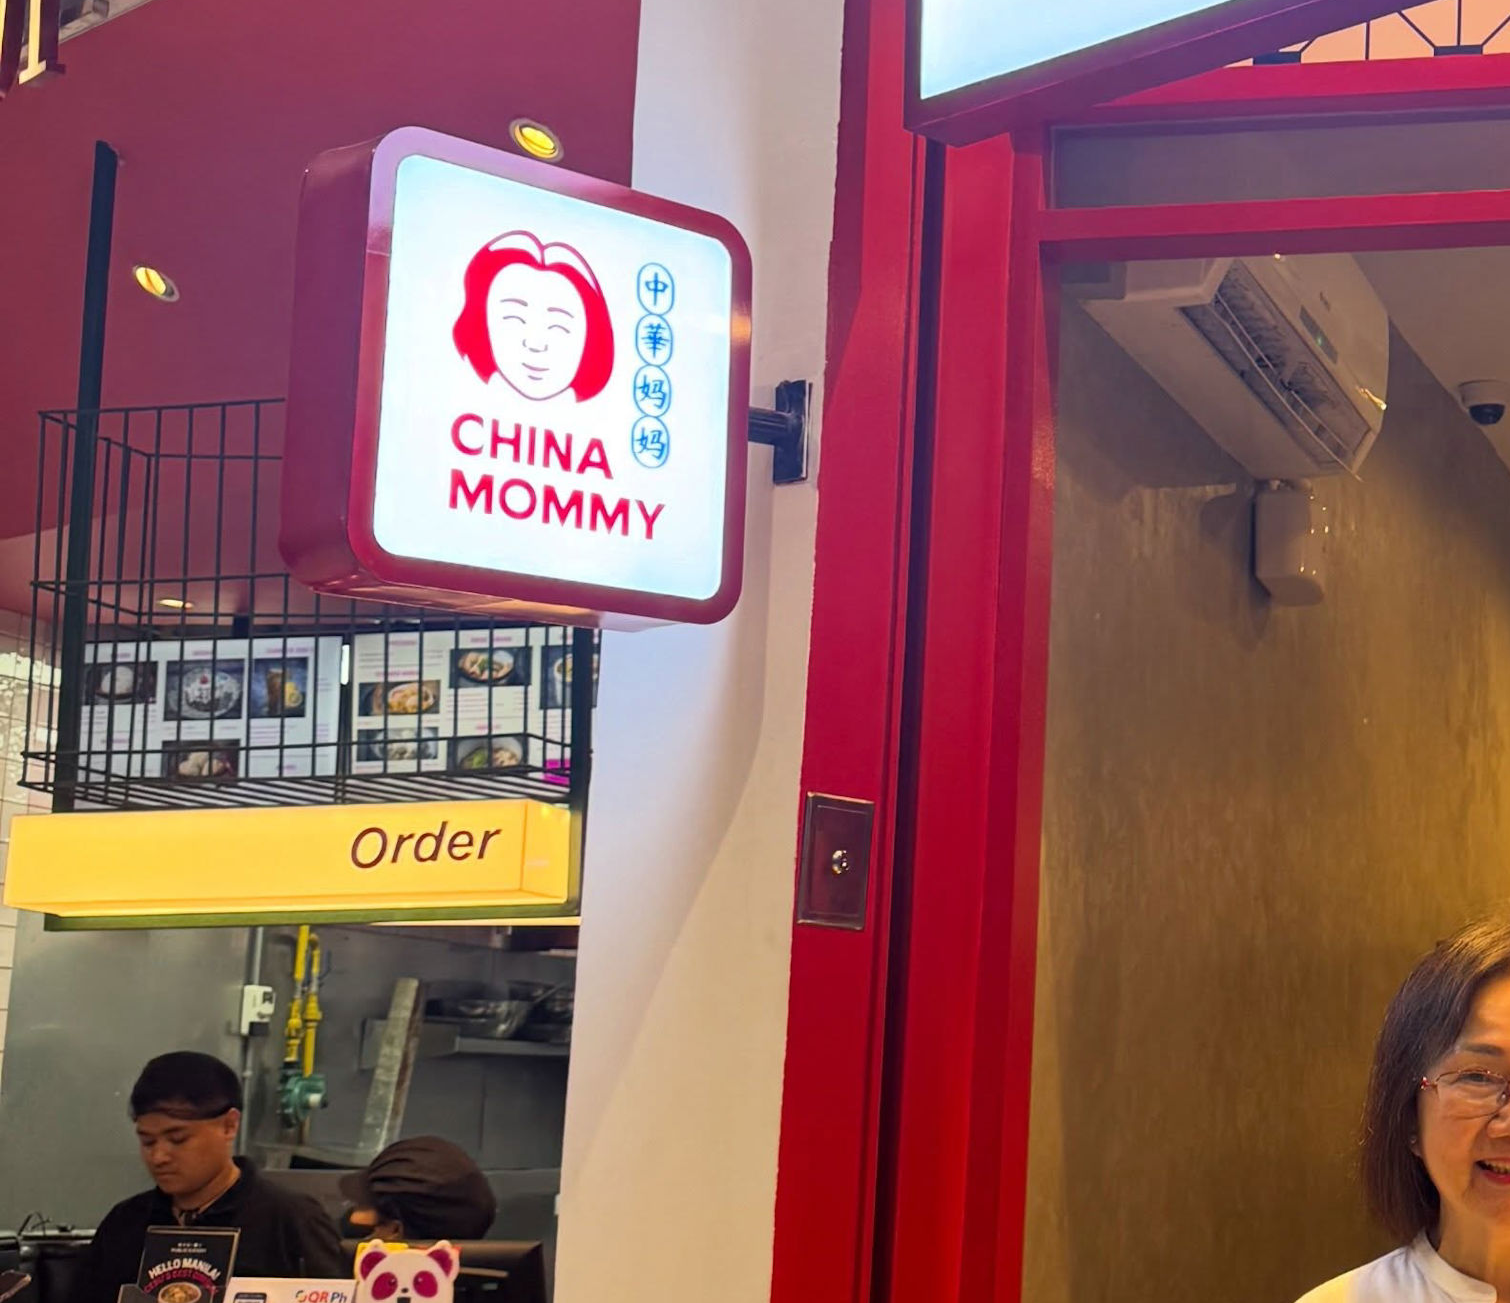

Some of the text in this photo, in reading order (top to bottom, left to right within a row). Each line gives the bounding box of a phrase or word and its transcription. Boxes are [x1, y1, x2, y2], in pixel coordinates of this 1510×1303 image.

[634, 271, 670, 461] 中華妈妈
[450, 412, 614, 480] CHINA
[448, 469, 666, 540] MOMMY
[350, 820, 502, 869] Order
[148, 1259, 181, 1279] HELLO
